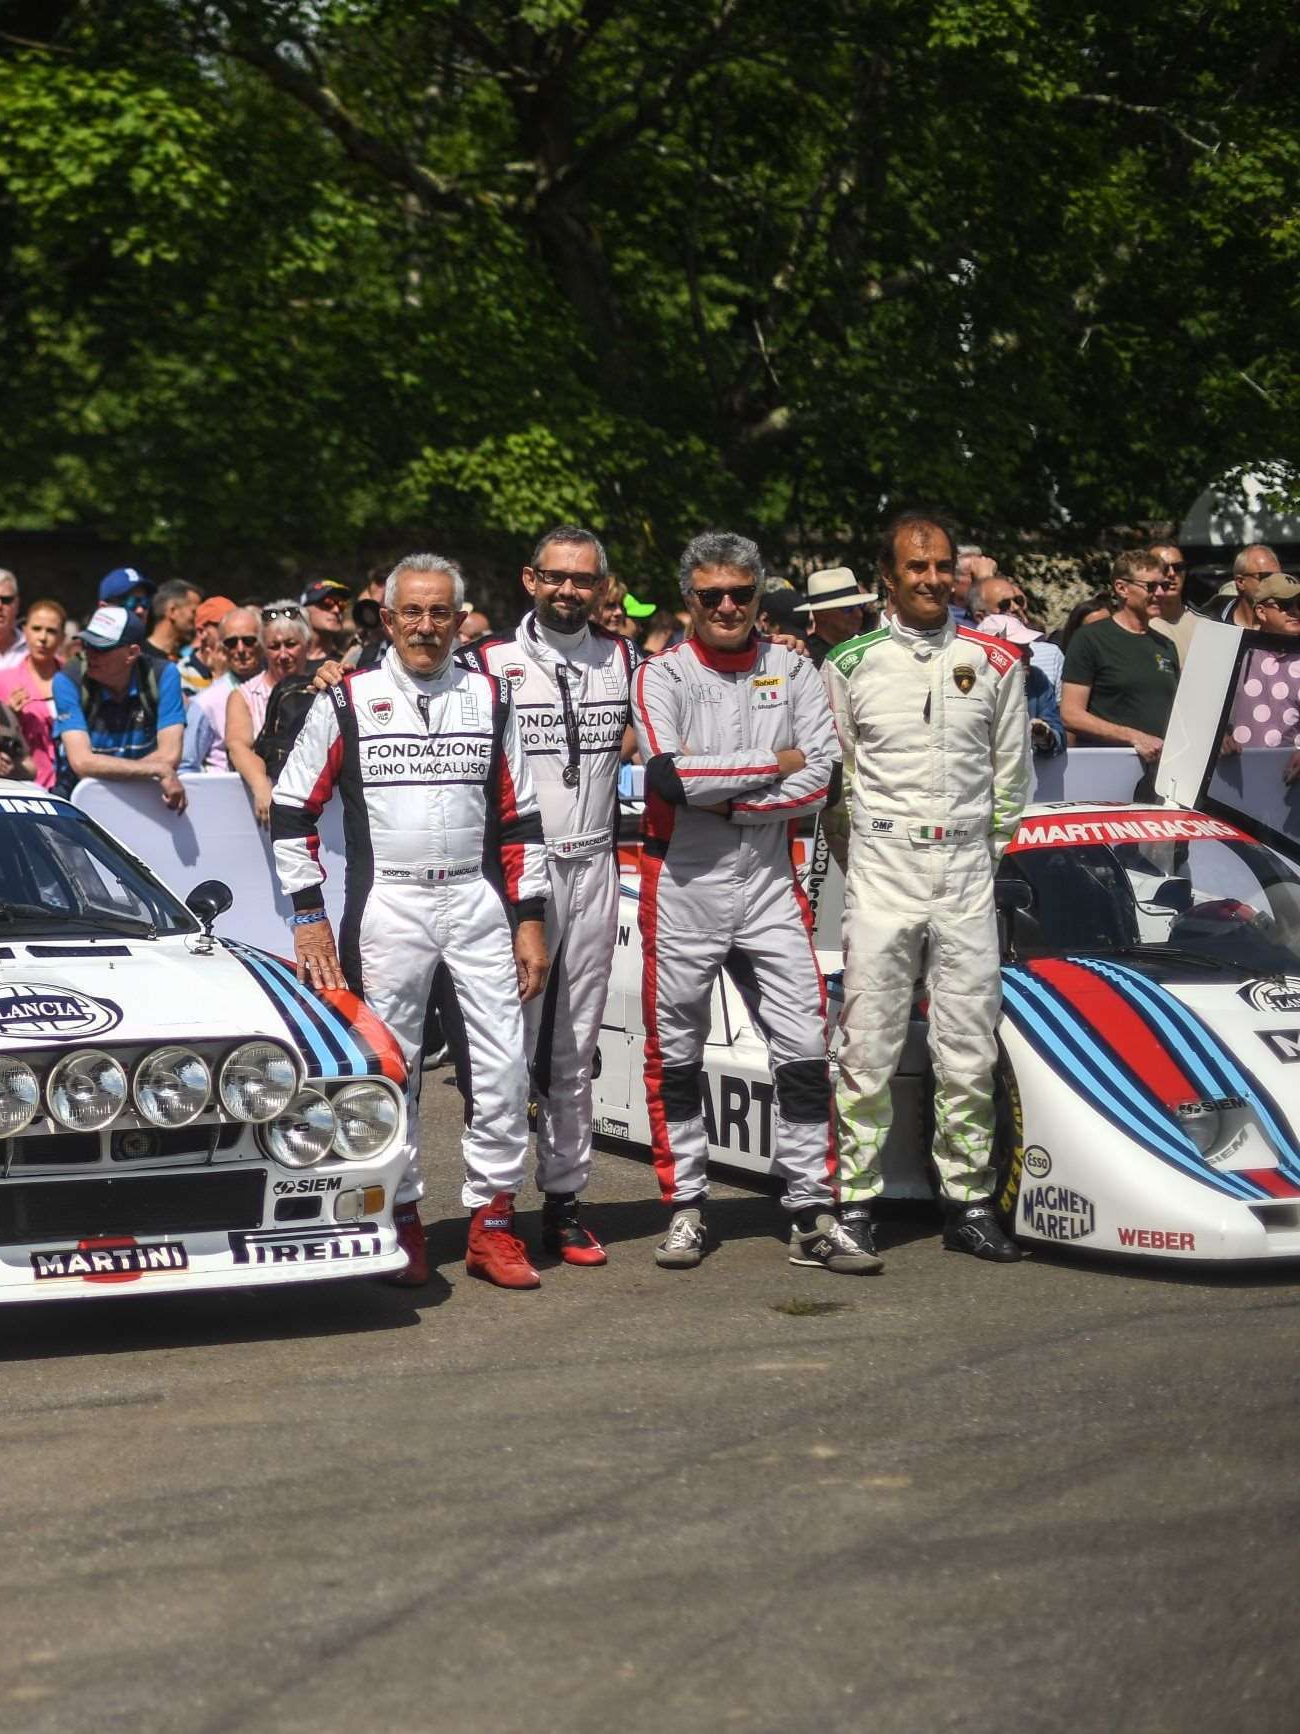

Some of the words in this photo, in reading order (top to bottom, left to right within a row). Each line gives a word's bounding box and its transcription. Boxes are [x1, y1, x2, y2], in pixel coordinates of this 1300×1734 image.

[367, 743, 492, 759] FONDAZIONE
[369, 763, 405, 776] GINO
[410, 762, 486, 775] MACALUSO
[871, 820, 894, 831] OMP
[1018, 820, 1149, 845] MARTINI
[1143, 818, 1239, 838] RACING
[297, 1177, 342, 1193] SIEM
[1023, 1186, 1096, 1225] MAGNETI
[1023, 1198, 1096, 1240] MARELLI
[228, 1222, 382, 1264] PIRELLI
[1117, 1227, 1196, 1251] WEBER
[37, 1247, 183, 1275] MARTINI
